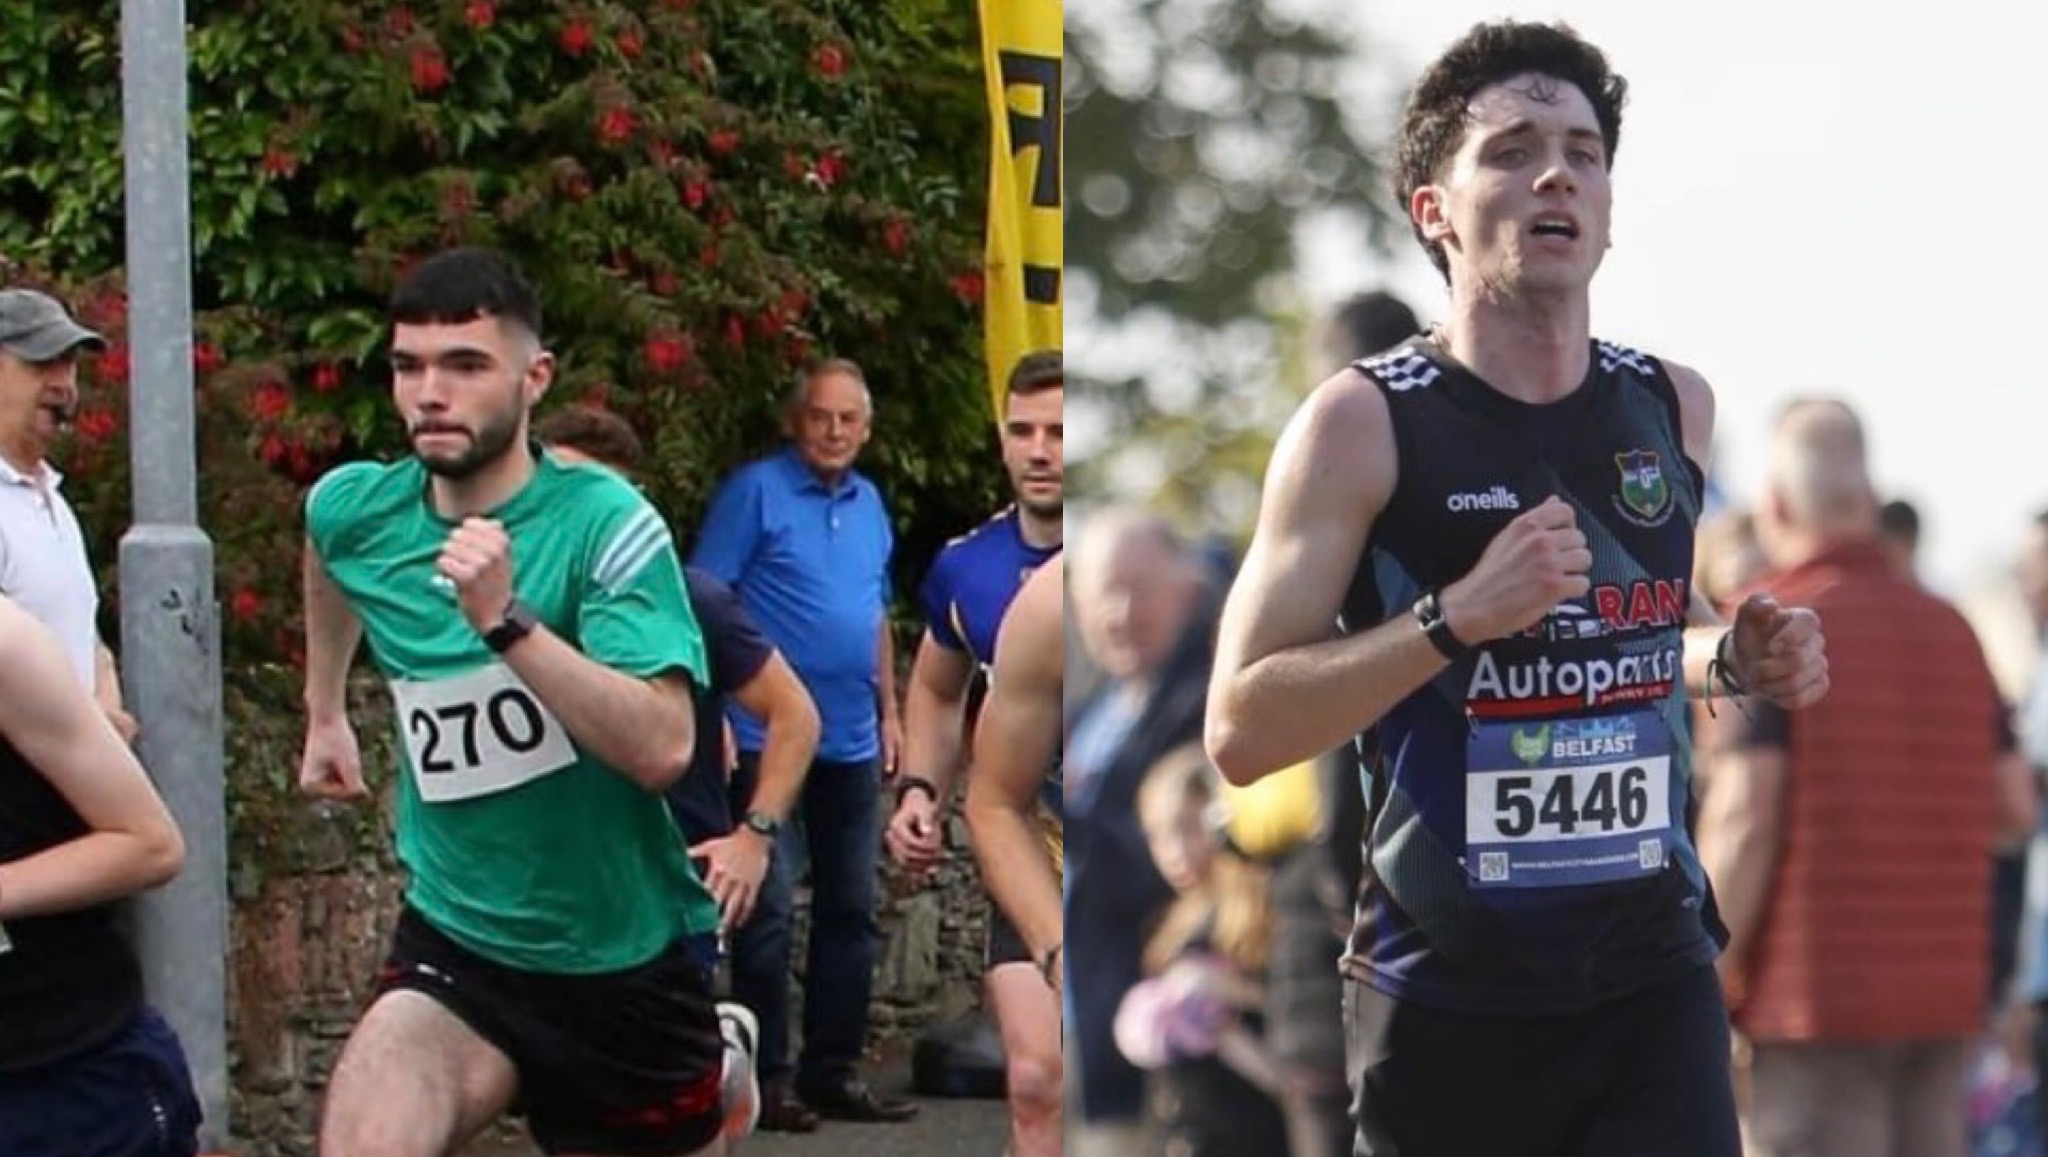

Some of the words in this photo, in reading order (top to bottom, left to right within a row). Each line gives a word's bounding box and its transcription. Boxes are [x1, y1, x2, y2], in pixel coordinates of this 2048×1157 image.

[411, 688, 545, 773] 270
[1552, 733, 1637, 758] BELFAST
[1494, 766, 1648, 837] 5446
